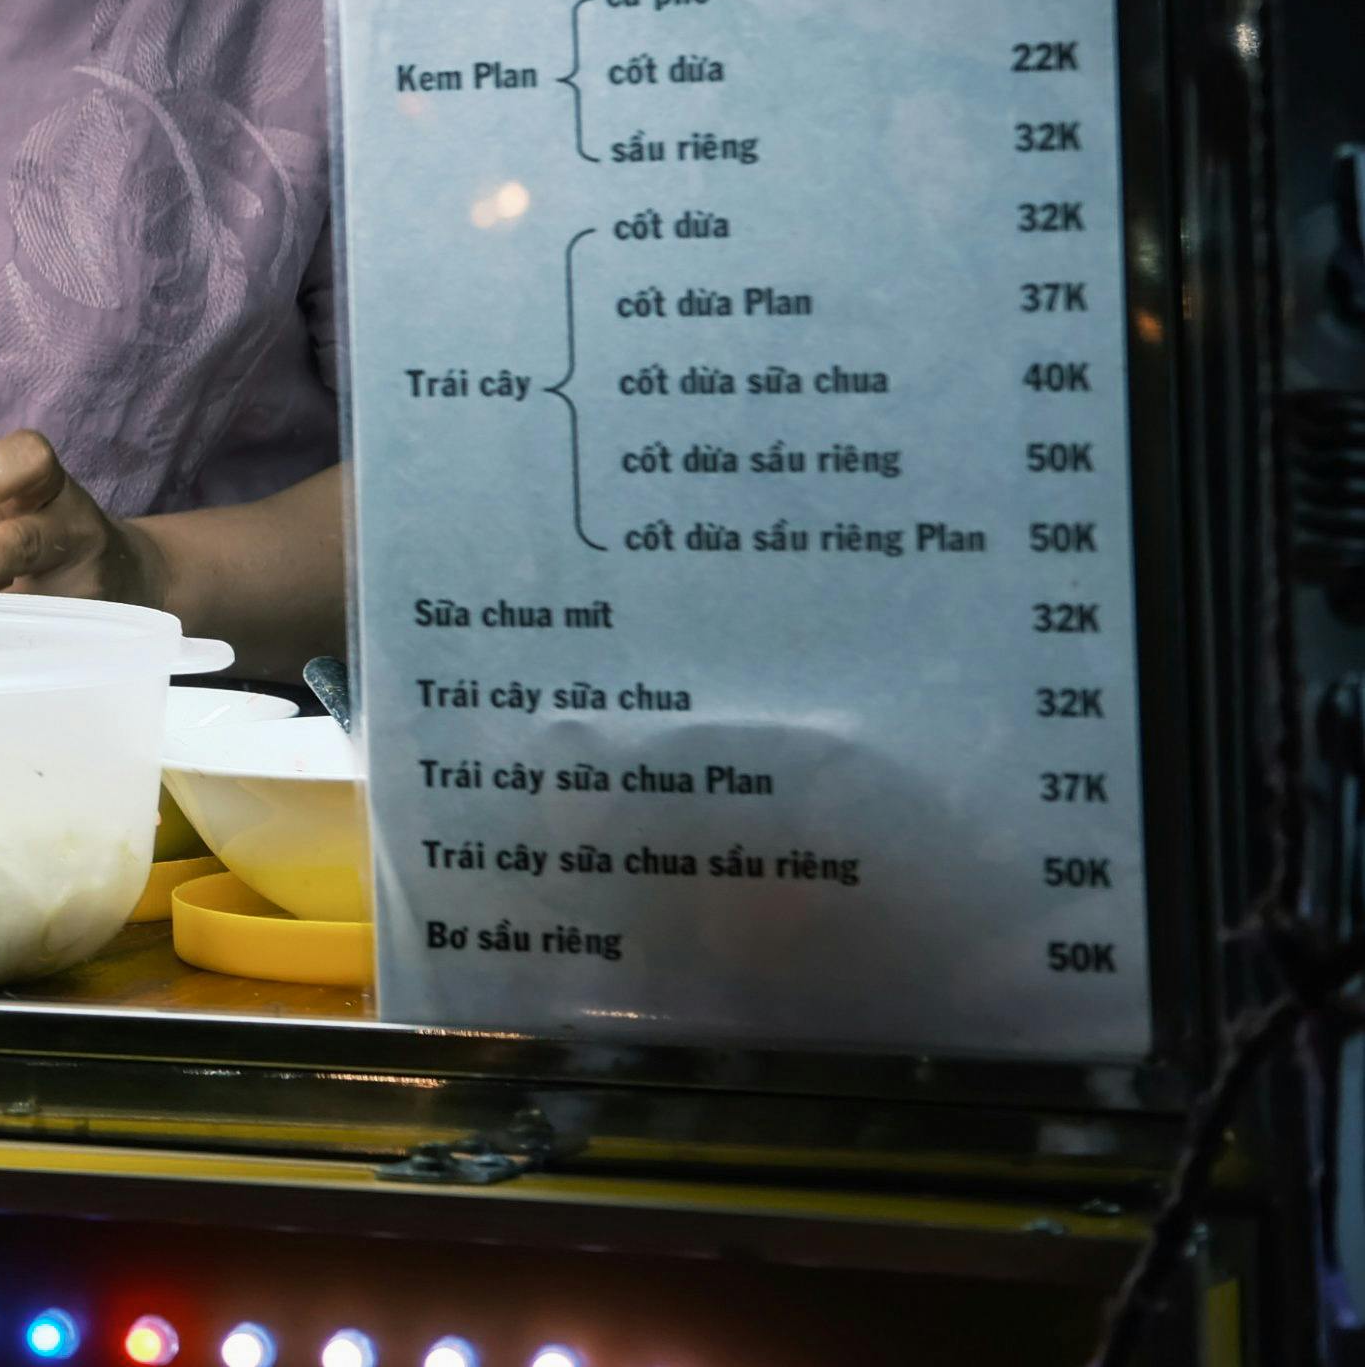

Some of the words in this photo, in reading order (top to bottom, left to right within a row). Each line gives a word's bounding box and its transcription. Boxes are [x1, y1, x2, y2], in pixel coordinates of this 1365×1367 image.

[607, 53, 658, 86] cốt
[668, 54, 725, 84] dừa
[1010, 40, 1079, 73] 22K
[396, 63, 463, 93] Kem
[473, 61, 538, 90] Plan
[610, 129, 666, 164] sầu
[676, 131, 760, 166] riêng
[1014, 121, 1082, 153] 32K
[613, 208, 664, 241] cốt
[673, 210, 731, 240] dừa
[1018, 201, 1085, 233] 32K
[615, 285, 667, 319] cốt
[676, 287, 734, 318] dừa
[743, 286, 813, 317] Plan
[1020, 282, 1088, 314] 37K
[404, 368, 469, 398] Trái
[478, 369, 532, 402] cây
[618, 363, 670, 396] cốt
[678, 365, 736, 395] dừa
[746, 365, 803, 396] sữa
[813, 364, 890, 395] chua
[1022, 361, 1091, 393] 40K
[620, 440, 673, 474] cốt
[681, 443, 739, 474] dừa
[749, 439, 806, 474] sầu
[816, 443, 902, 479] riêng
[1025, 442, 1094, 473] 50K
[624, 518, 675, 552] cốt
[684, 522, 742, 552] dừa
[752, 518, 809, 553] sầu
[819, 522, 905, 558] riêng
[915, 522, 987, 553] Plan
[1029, 521, 1097, 554] 50K
[413, 598, 471, 628] Sữa
[480, 599, 554, 629] chua
[1032, 602, 1100, 634] 32K
[415, 678, 479, 708] Trái
[489, 681, 542, 715] cây
[552, 681, 608, 711] sữa
[617, 681, 692, 712] chua
[1036, 687, 1104, 719] 32K
[418, 758, 482, 789] Trái
[492, 761, 545, 796] cây
[555, 762, 610, 792] sữa
[620, 762, 695, 794] chua
[704, 764, 773, 796] Plan
[1040, 771, 1108, 803] 37K
[421, 839, 485, 870] Trái
[495, 843, 549, 877] cây
[558, 844, 614, 874] sữa
[623, 845, 698, 877] chua
[707, 843, 765, 879] sầu
[775, 849, 861, 887] riêng
[1043, 856, 1112, 889] 50K
[424, 919, 469, 950] Bơ
[477, 918, 531, 953] sầu
[540, 924, 623, 963] riêng
[1047, 941, 1117, 973] 50K
